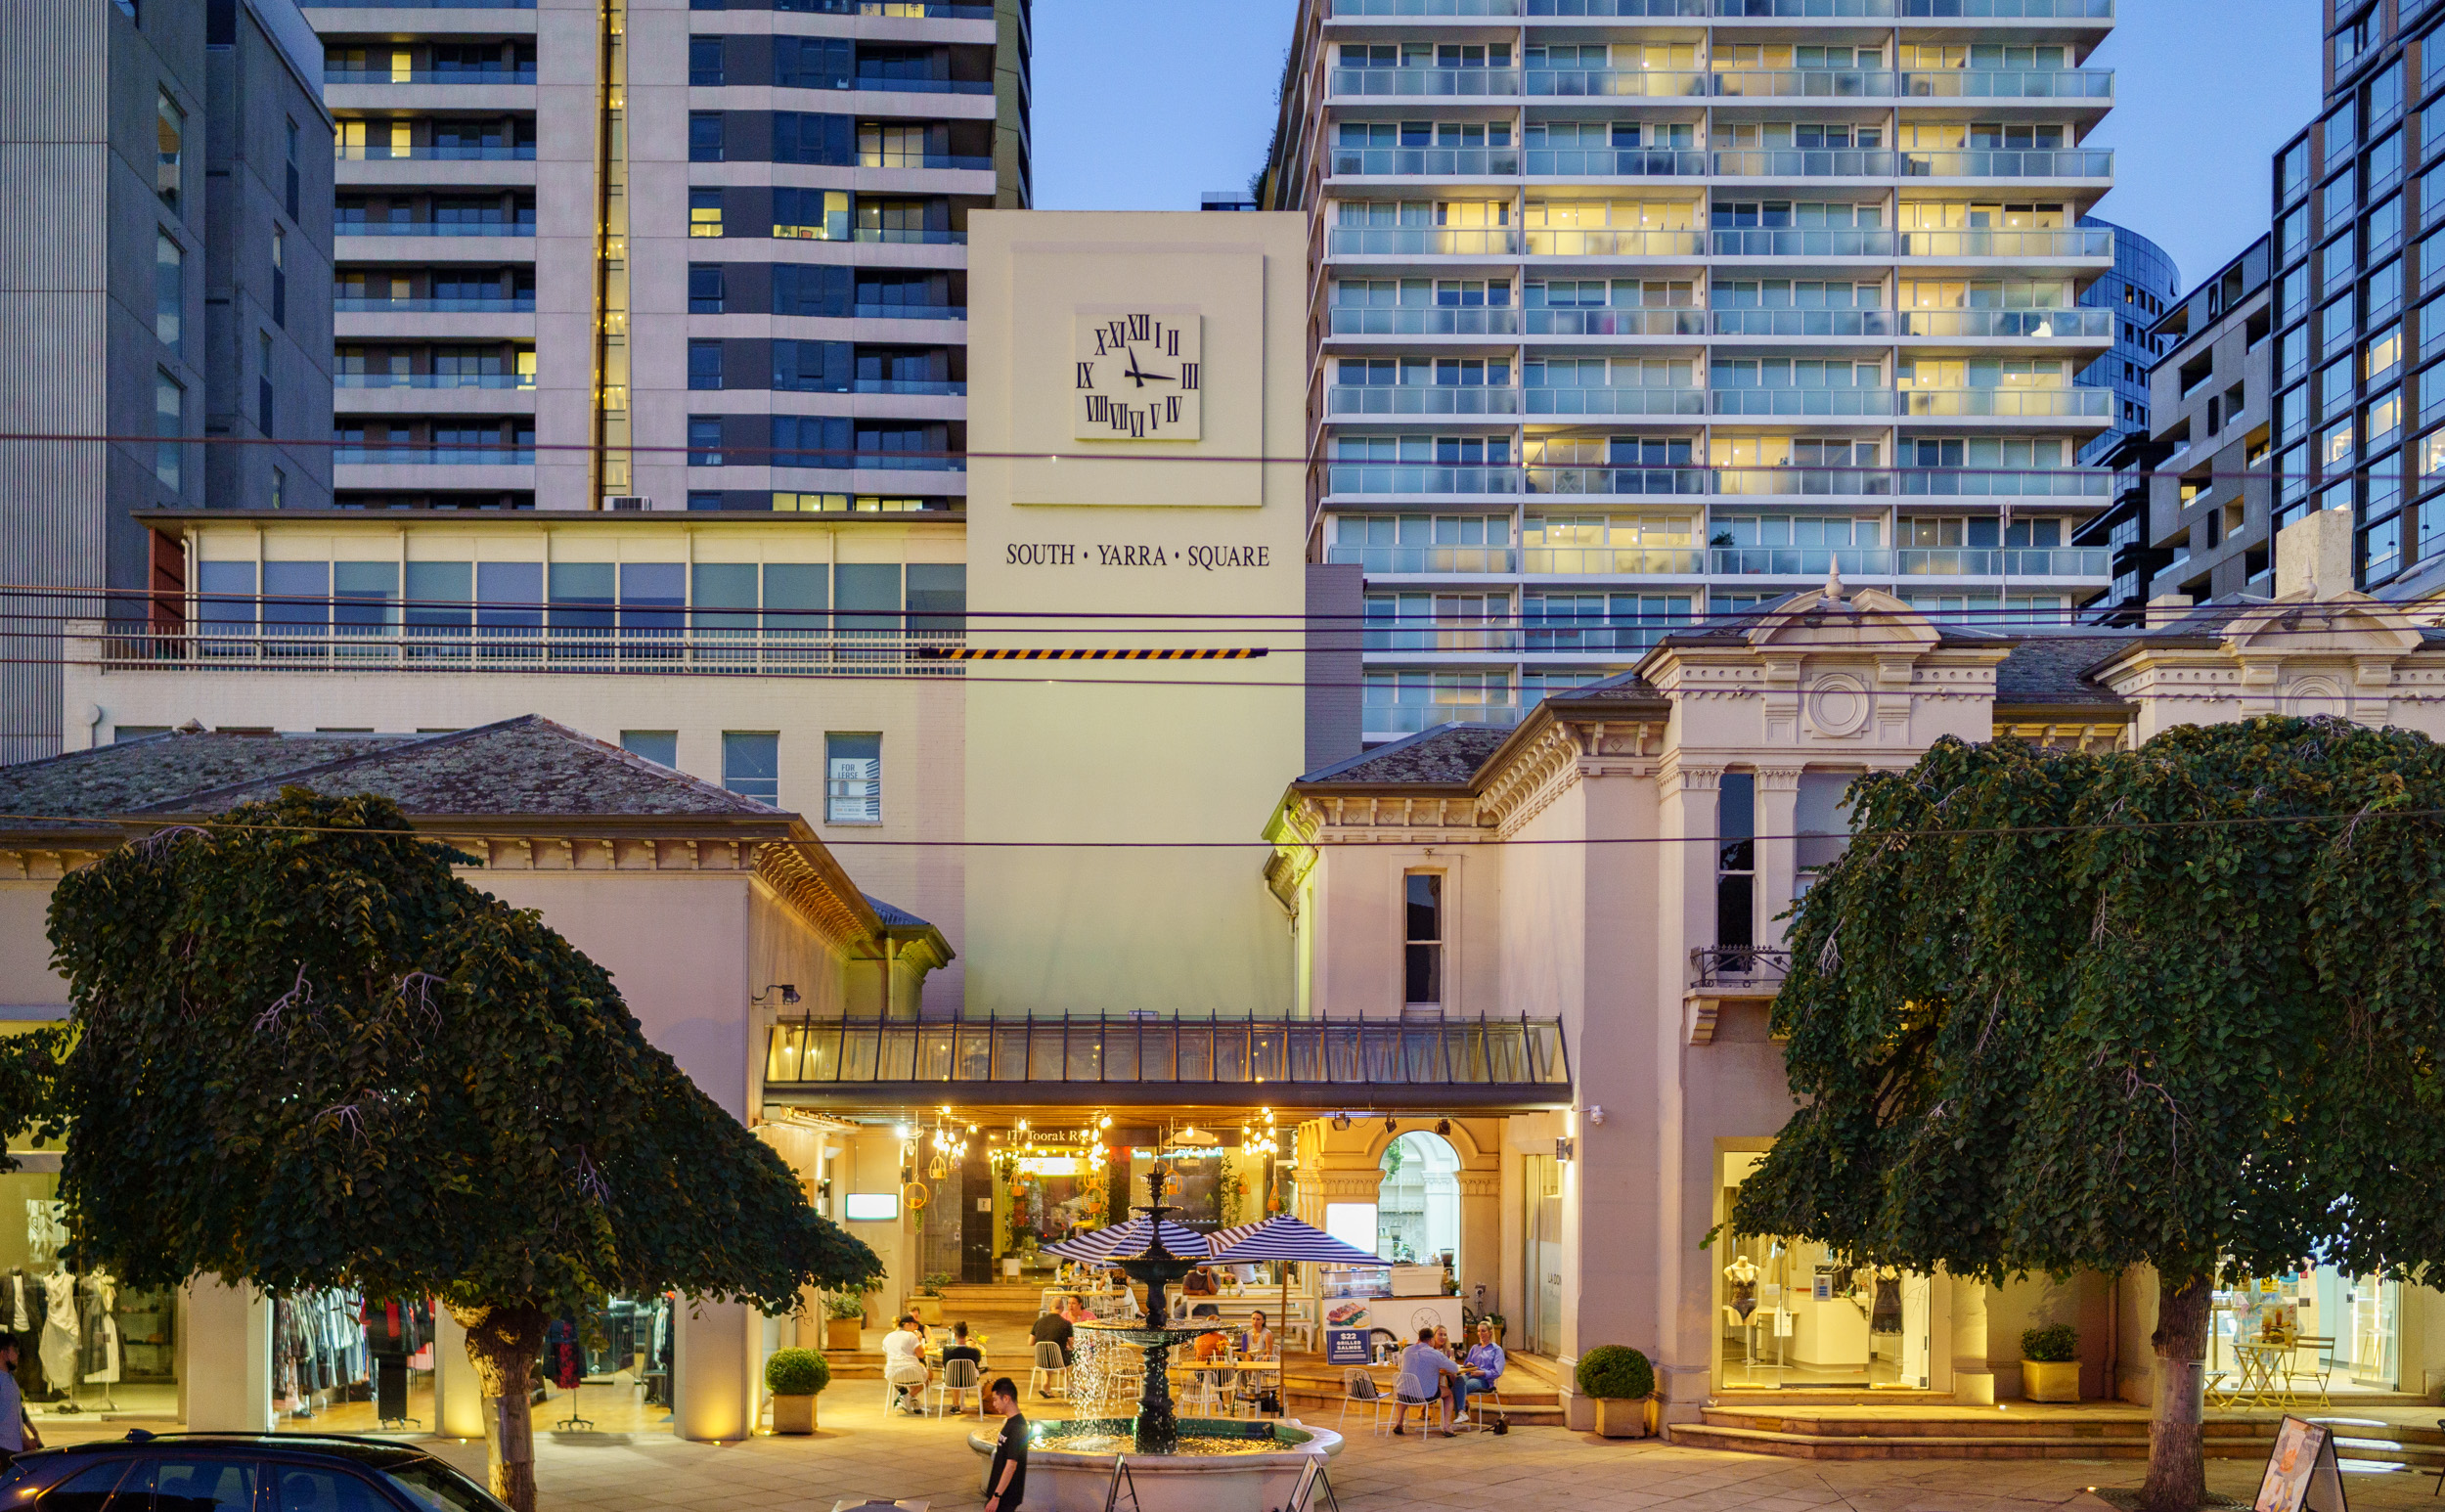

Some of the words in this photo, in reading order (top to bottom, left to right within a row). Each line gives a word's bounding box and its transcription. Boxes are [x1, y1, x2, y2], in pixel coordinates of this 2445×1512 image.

[1107, 321, 1126, 348] XI
[1127, 314, 1150, 340] XII
[1154, 322, 1162, 348] I
[1093, 329, 1108, 355] X
[1167, 330, 1179, 356] II
[1076, 362, 1094, 388] IX
[1180, 363, 1199, 389] III
[1085, 395, 1108, 422] VIII
[1108, 403, 1129, 429] VII
[1149, 403, 1161, 429] V
[1166, 396, 1182, 422] IV
[1128, 411, 1145, 437] VI
[1006, 543, 1075, 565] SOUTH
[1097, 545, 1168, 566] YARRA
[1187, 545, 1269, 571] SQUARE
[1007, 1130, 1024, 1140] 177
[1027, 1130, 1066, 1141] Toorak
